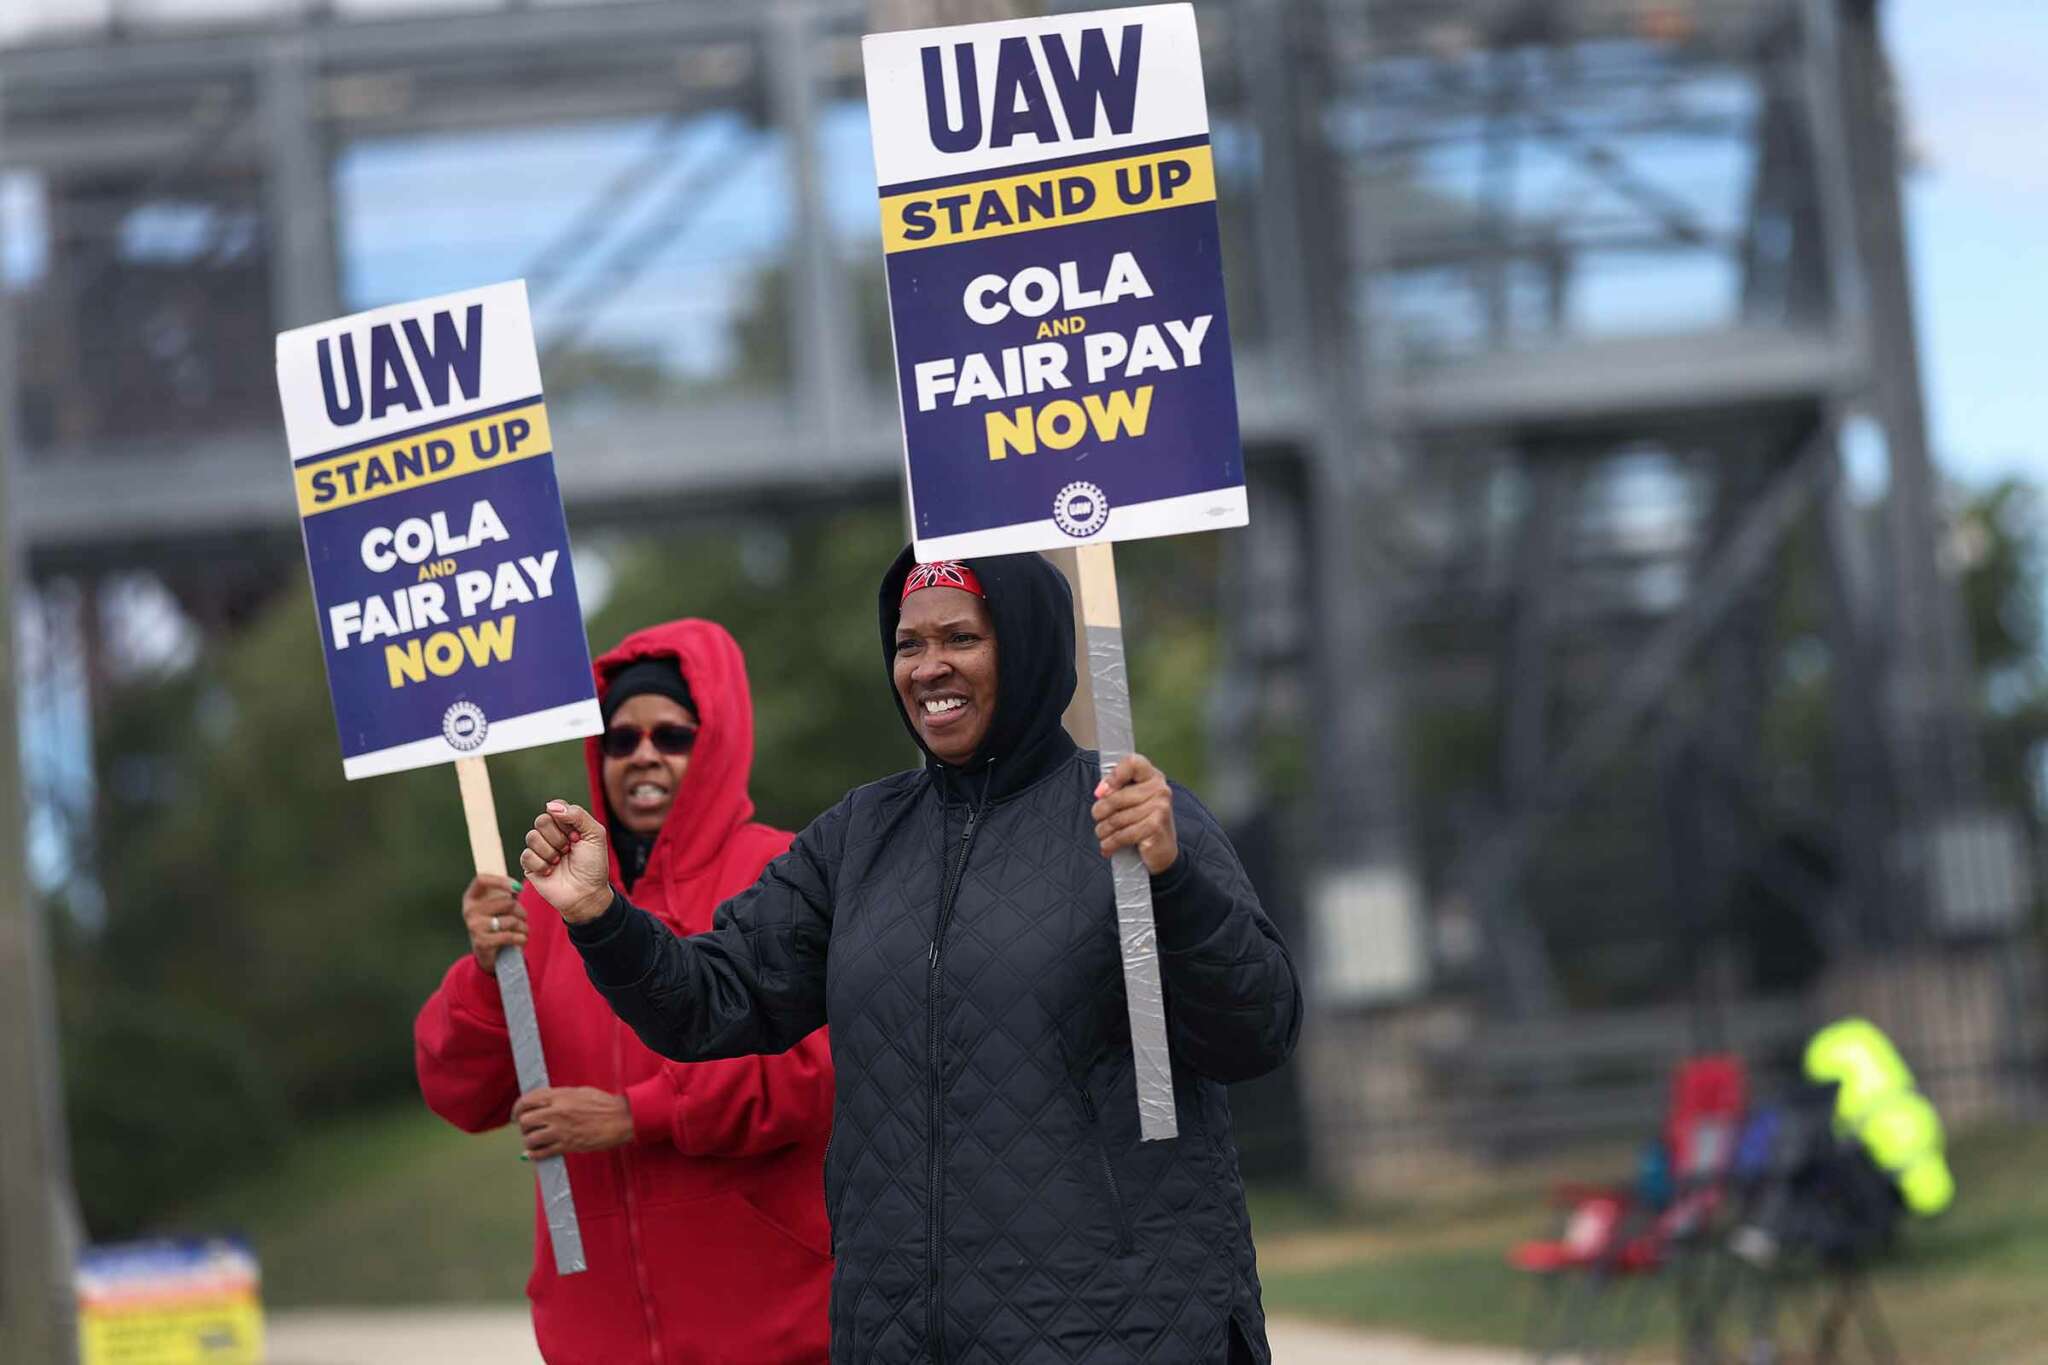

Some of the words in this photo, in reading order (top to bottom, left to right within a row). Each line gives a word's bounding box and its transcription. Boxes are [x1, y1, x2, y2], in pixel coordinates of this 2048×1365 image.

[920, 23, 1143, 154] UAW
[901, 175, 1096, 240] STAND
[1115, 159, 1191, 205] UP
[963, 251, 1153, 325] COLA
[1036, 315, 1087, 339] AND
[317, 304, 483, 427] UAW
[914, 342, 1072, 412] FAIR
[1084, 314, 1213, 384] PAY
[312, 439, 455, 504] STAND
[470, 419, 530, 459] UP
[984, 385, 1154, 461] NOW
[360, 499, 510, 573] COLA
[417, 559, 457, 582] AND
[329, 582, 449, 650] FAIR
[456, 550, 559, 617] PAY
[384, 615, 516, 689] NOW
